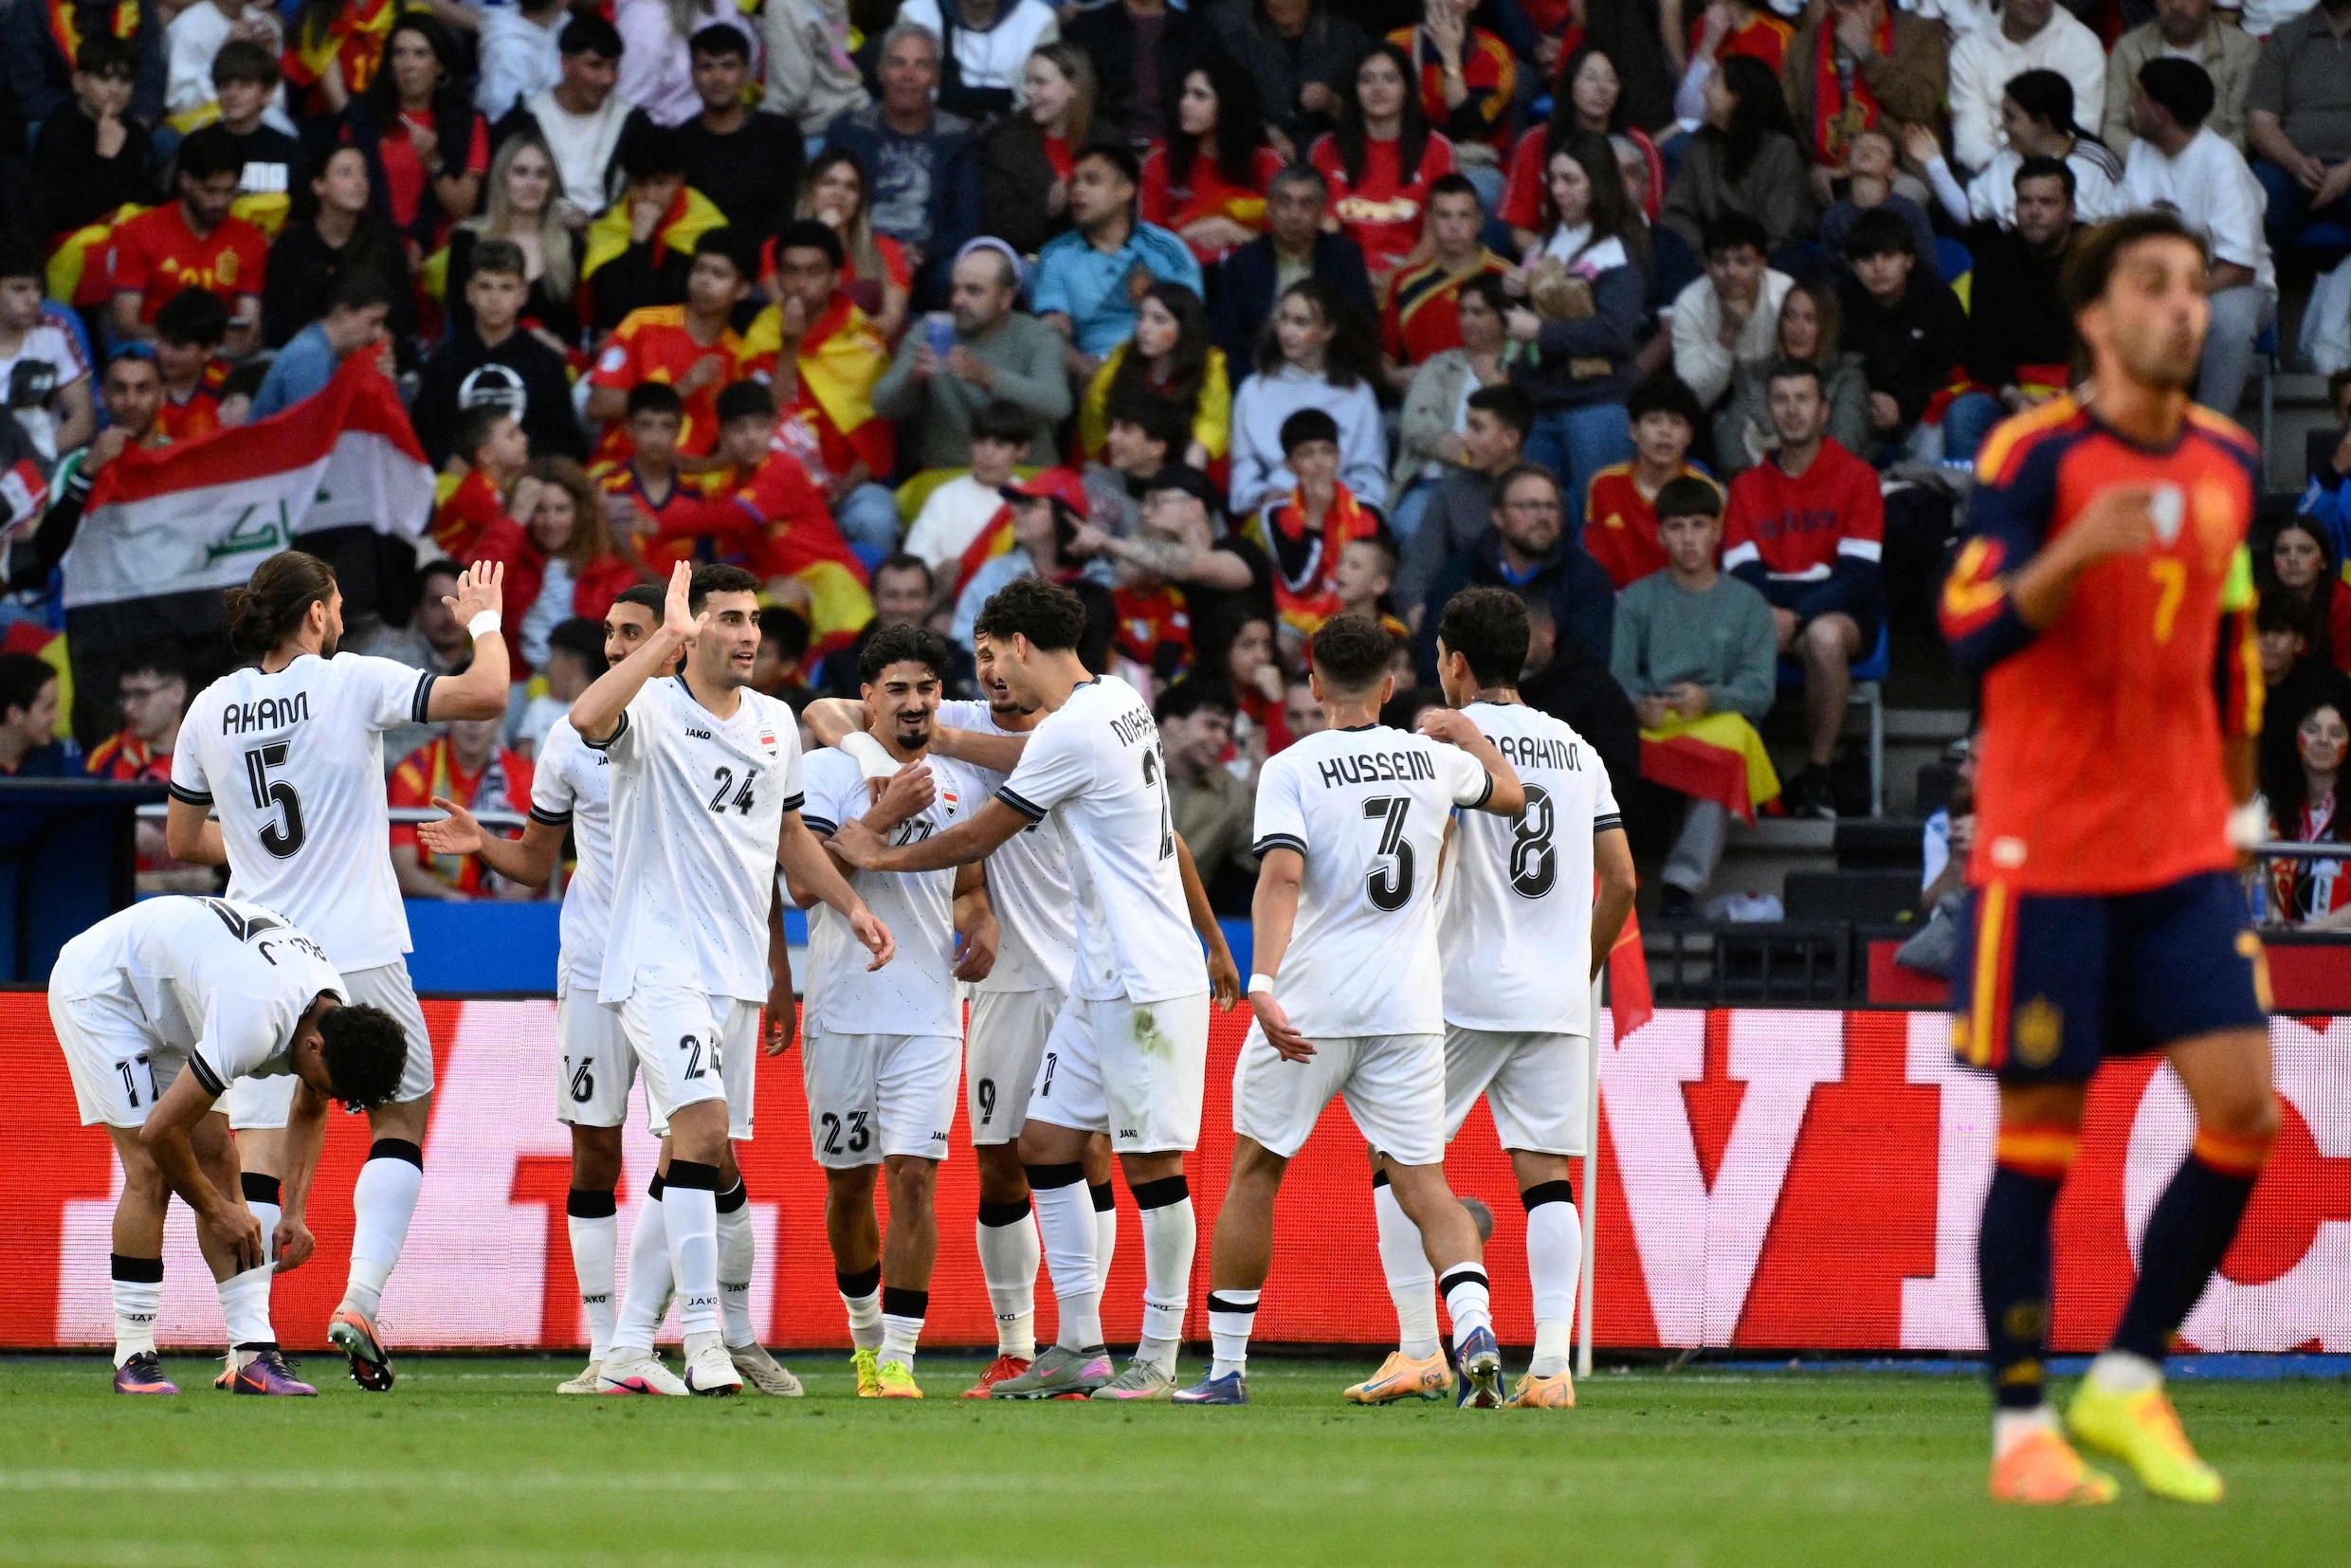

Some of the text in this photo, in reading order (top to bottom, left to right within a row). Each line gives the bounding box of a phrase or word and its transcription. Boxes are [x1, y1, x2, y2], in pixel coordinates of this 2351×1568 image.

[2148, 556, 2187, 645] 7
[223, 691, 309, 736] AKAM
[684, 727, 711, 740] JAKO
[597, 757, 610, 766] JA
[1318, 750, 1436, 789] HUSSEIN
[1483, 735, 1582, 772] RAHIM
[245, 739, 306, 860] 5
[708, 765, 759, 816] 24
[1142, 738, 1175, 862] 2
[1361, 794, 1416, 912] 3
[1509, 782, 1558, 900] 8
[115, 1050, 159, 1109] 17
[977, 1076, 996, 1125] 9
[821, 1109, 870, 1156] 23
[1120, 1128, 1138, 1139] JAKO
[687, 1296, 719, 1306] JAKO
[727, 1283, 750, 1293] JAK
